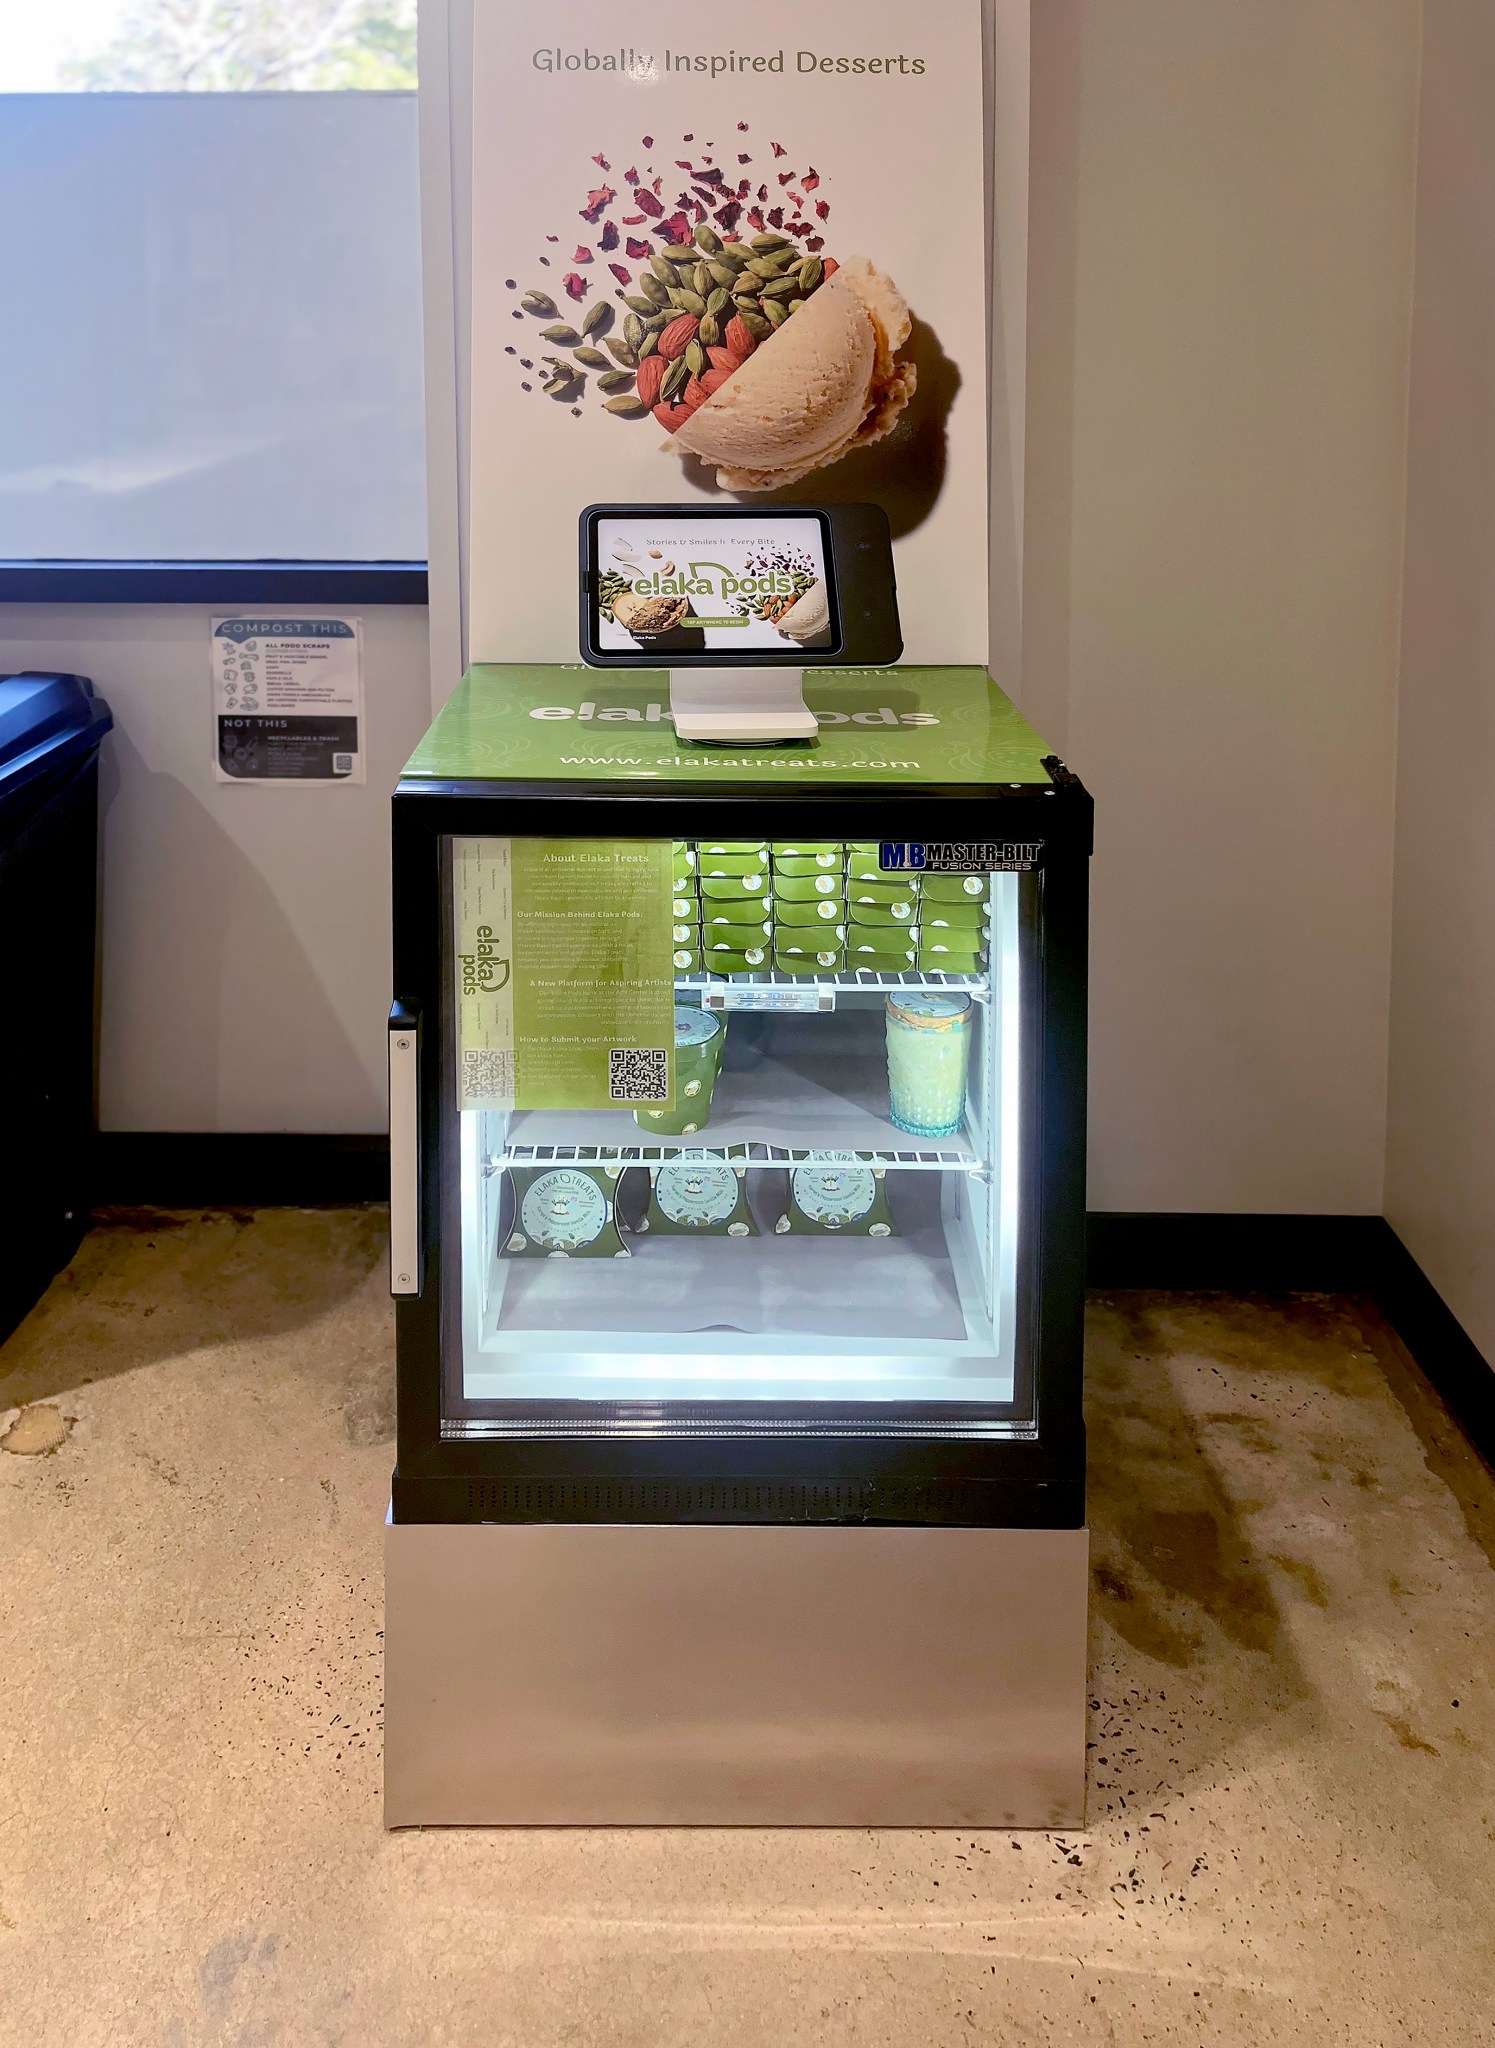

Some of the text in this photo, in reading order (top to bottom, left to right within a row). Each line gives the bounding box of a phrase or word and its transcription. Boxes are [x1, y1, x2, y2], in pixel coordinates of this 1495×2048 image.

[664, 49, 785, 78] Inspired
[796, 51, 926, 75] Desserts
[646, 538, 677, 546] Stories
[688, 538, 718, 546] Smiles
[730, 538, 755, 547] Every
[757, 538, 775, 546] Bite
[634, 571, 792, 600] elaka pods
[221, 623, 348, 634] COMPOST THIS
[801, 668, 898, 676] esserts
[529, 702, 941, 726] elak ods
[224, 719, 288, 728] NOT THIS
[559, 755, 921, 769] www.elakatreats.com
[543, 854, 650, 863] About Elaka Treats
[882, 842, 1041, 869] MB MASTER-BILT
[932, 862, 1032, 870] FUSION SERIES
[597, 911, 620, 919] Elaka
[621, 911, 643, 919] Pods:
[477, 925, 501, 982] elaka
[458, 955, 481, 996] pods
[558, 979, 594, 988] Platform
[595, 979, 608, 988] for
[609, 979, 643, 988] Aspiring
[644, 979, 672, 987] Artists
[534, 1176, 597, 1201] ELAKA TREATS
